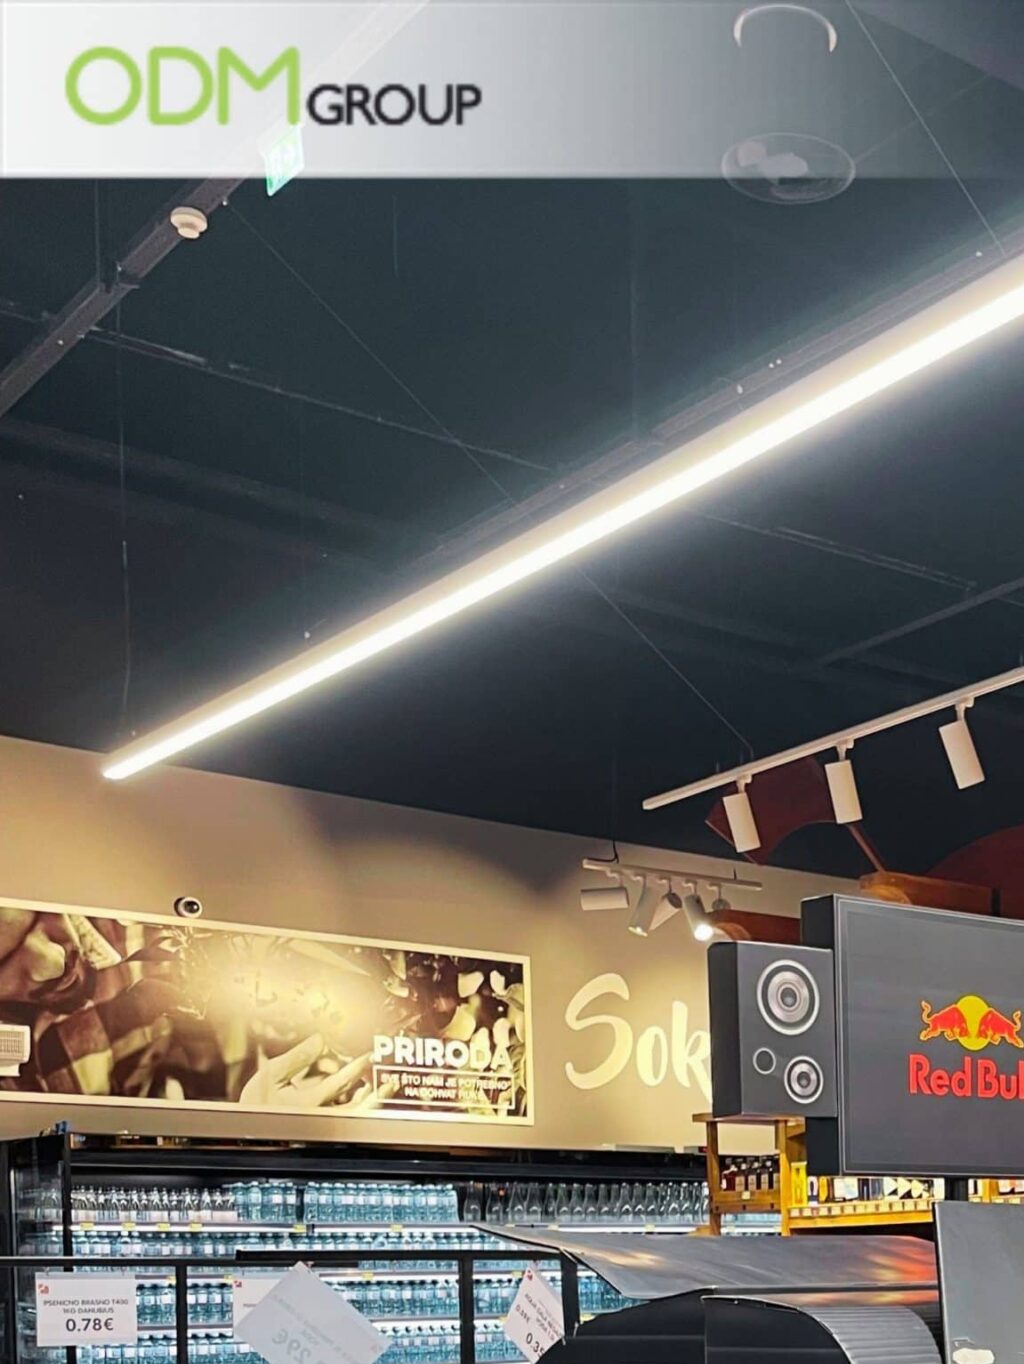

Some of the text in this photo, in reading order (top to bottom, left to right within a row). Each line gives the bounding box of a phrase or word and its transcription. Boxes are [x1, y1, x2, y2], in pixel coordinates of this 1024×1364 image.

[372, 1034, 514, 1072] PRIRODA
[909, 1054, 972, 1097] Red
[65, 1318, 114, 1333] 0.78€
